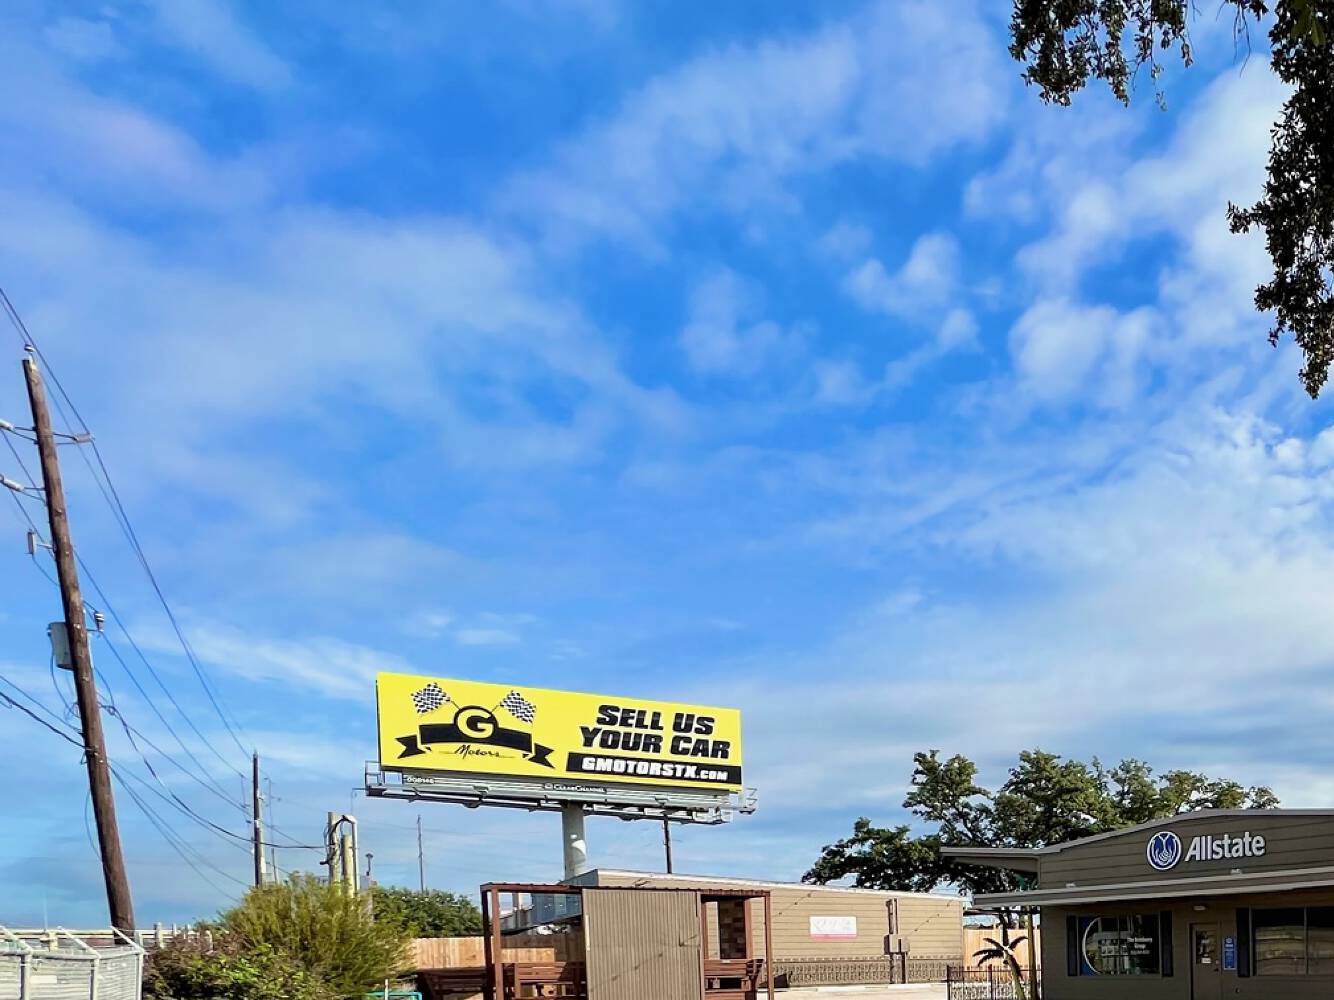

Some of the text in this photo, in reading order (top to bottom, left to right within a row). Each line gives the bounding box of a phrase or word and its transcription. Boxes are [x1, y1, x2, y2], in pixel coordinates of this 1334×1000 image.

[456, 708, 496, 739] G
[596, 704, 715, 735] SELL US
[454, 744, 501, 759] Motors
[580, 726, 731, 759] YOUR CAR
[1184, 831, 1266, 862] Allstate
